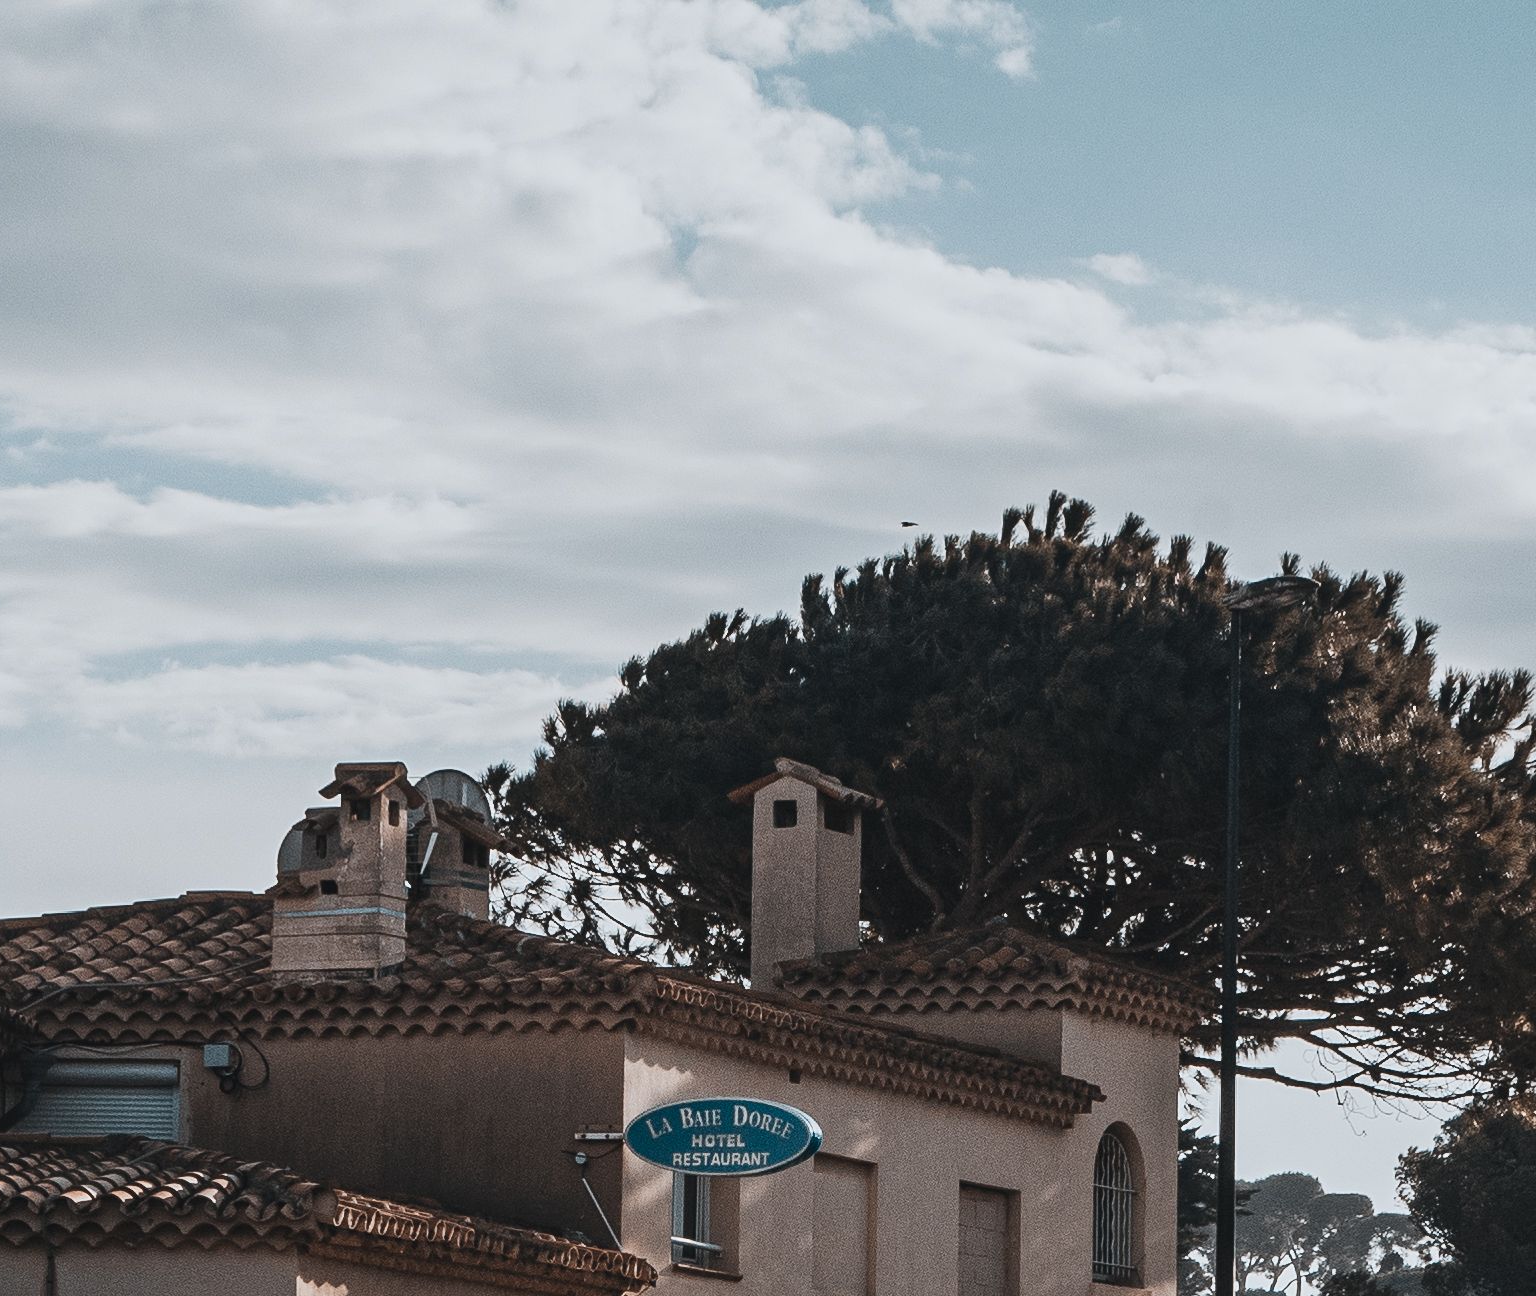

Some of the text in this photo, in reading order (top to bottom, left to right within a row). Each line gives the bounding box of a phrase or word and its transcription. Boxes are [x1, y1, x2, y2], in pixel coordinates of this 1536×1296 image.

[646, 1118, 672, 1138] LA
[679, 1108, 722, 1128] BAIE
[692, 1134, 745, 1147] HOTEL
[673, 1151, 769, 1165] RESTAURANT
